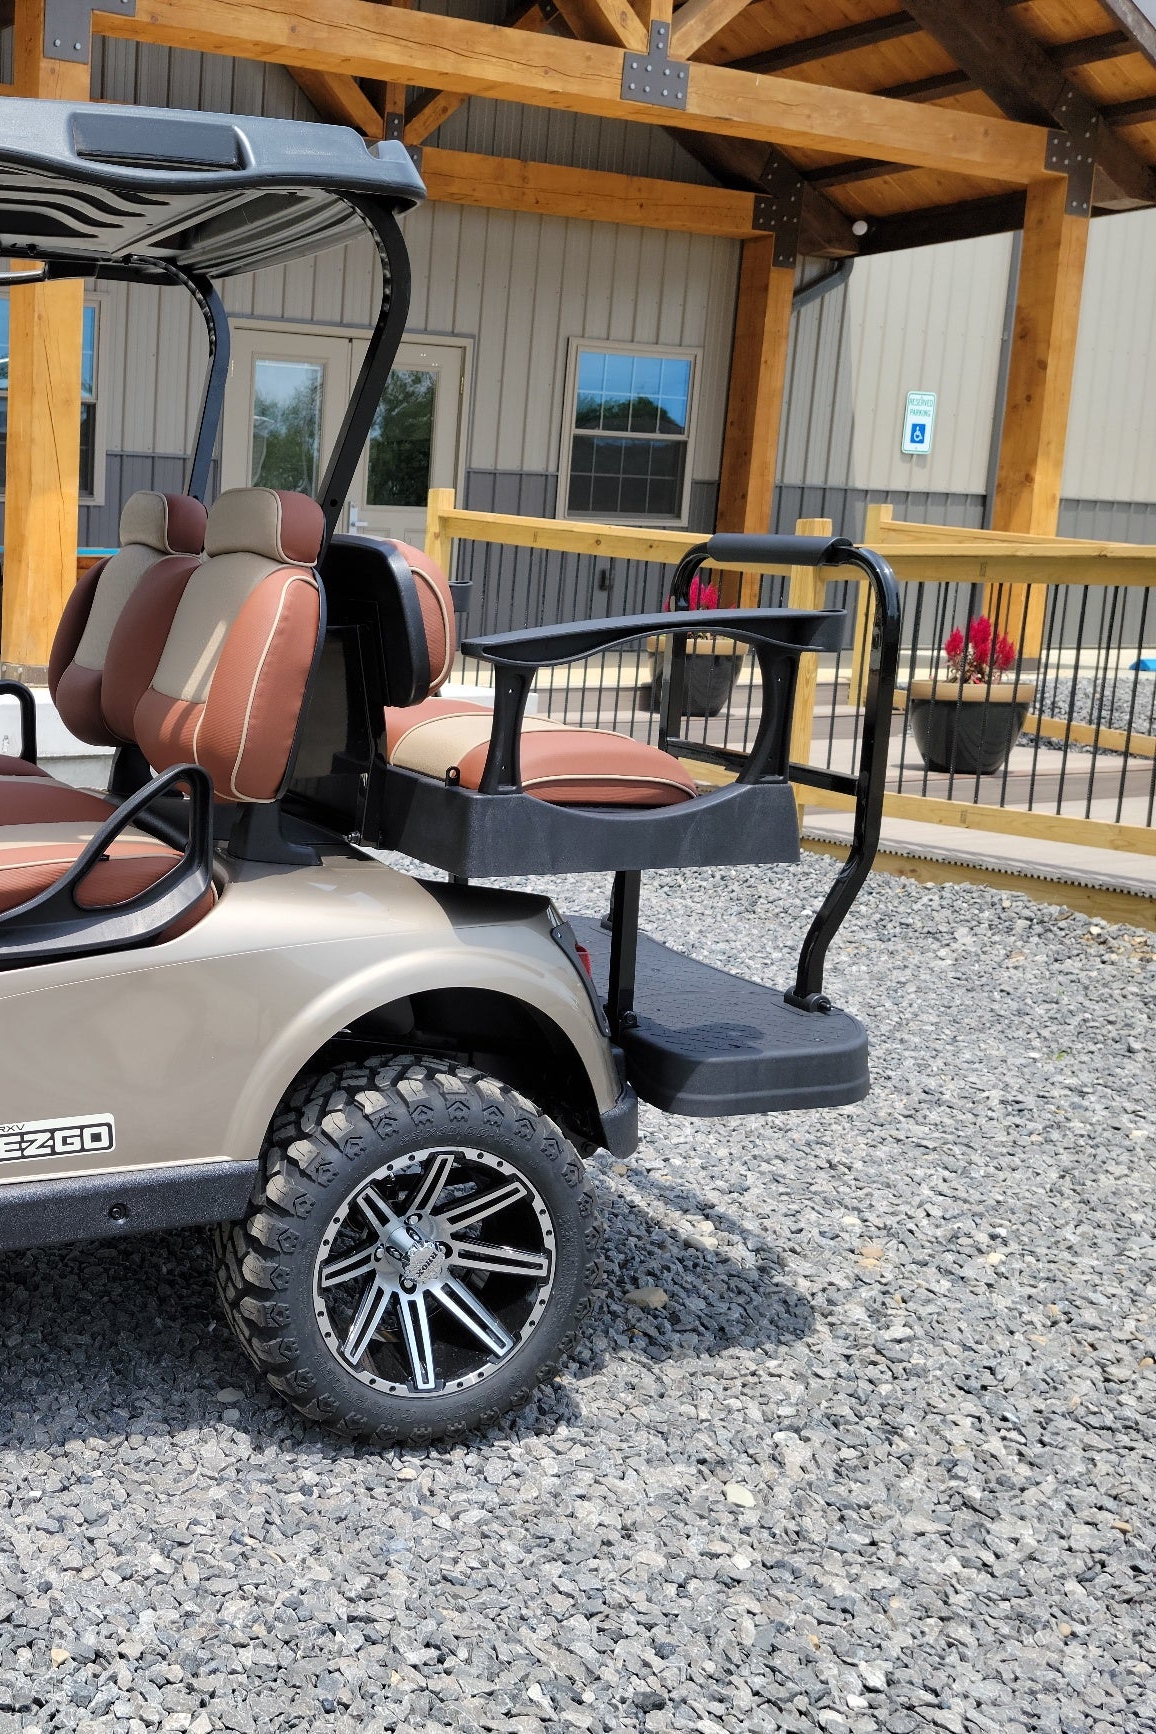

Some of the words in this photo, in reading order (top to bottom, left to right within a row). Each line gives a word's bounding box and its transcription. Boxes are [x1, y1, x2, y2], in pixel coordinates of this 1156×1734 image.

[908, 398, 934, 407] RESERVED
[909, 408, 931, 417] PARKING
[416, 1251, 438, 1278] RHOX
